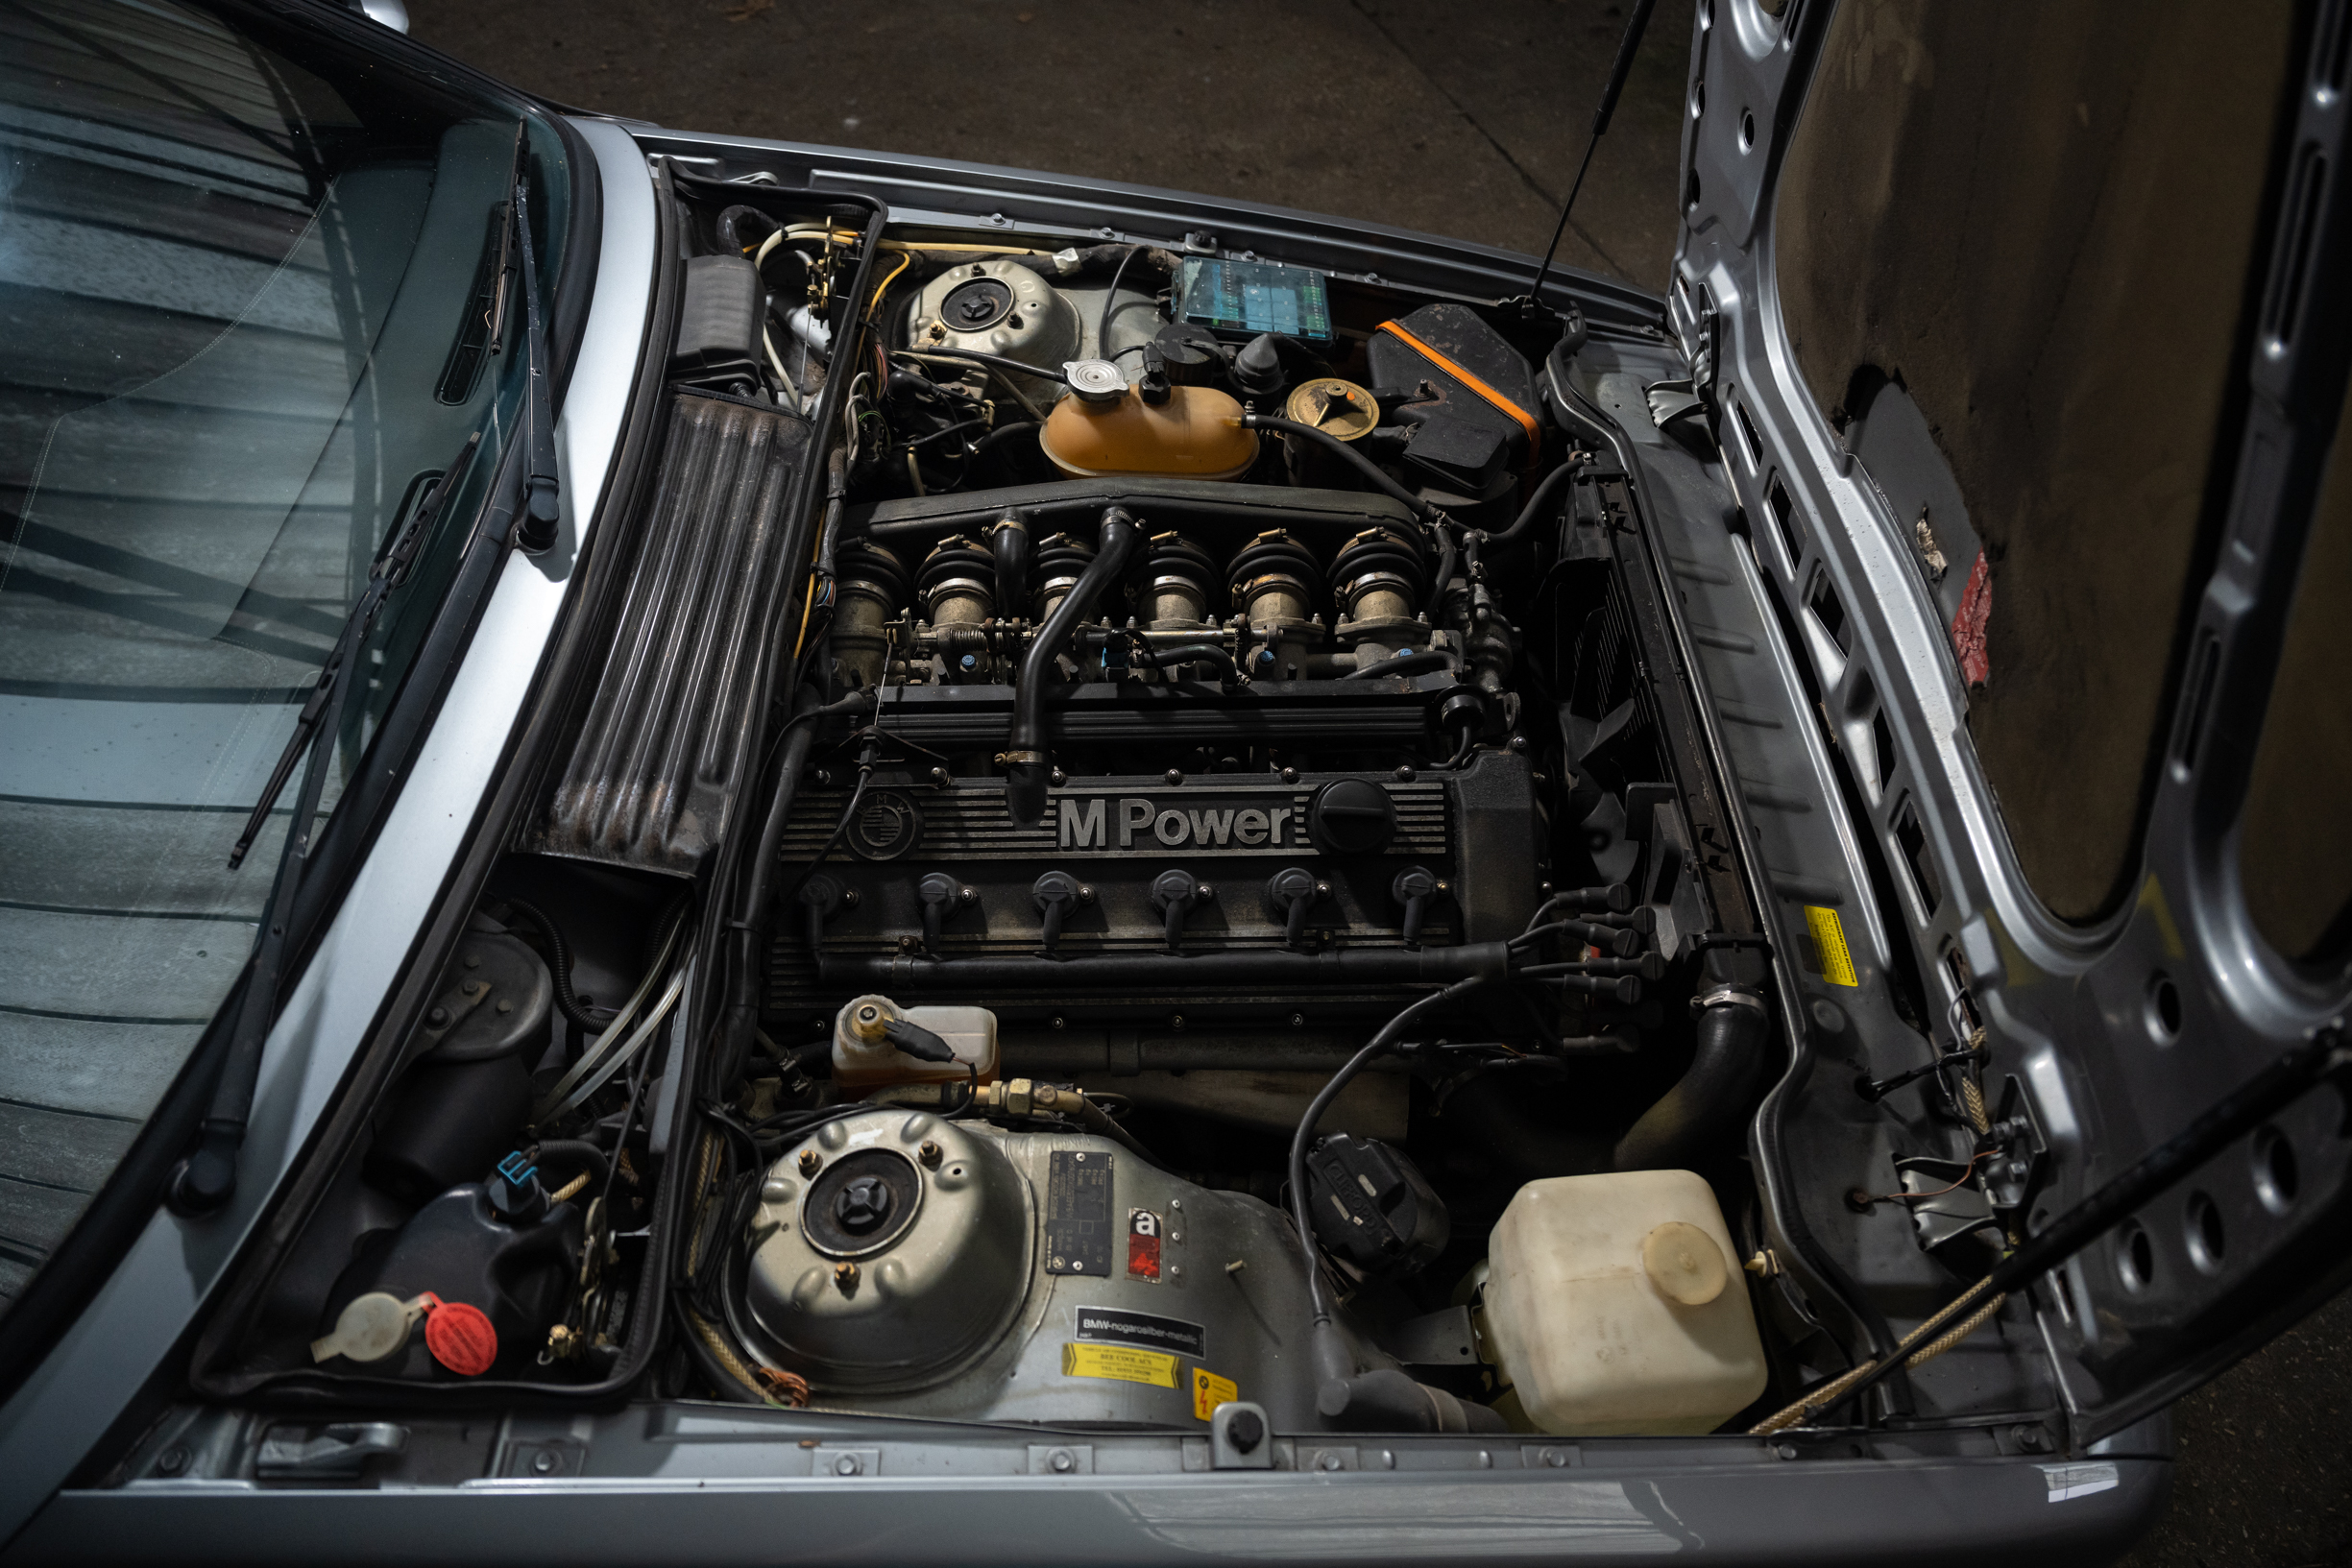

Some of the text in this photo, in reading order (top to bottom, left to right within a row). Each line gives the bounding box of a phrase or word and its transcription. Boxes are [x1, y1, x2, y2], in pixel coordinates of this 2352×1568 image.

[856, 793, 910, 815] BMW
[1060, 798, 1292, 847] M Power
[1327, 1163, 1379, 1231] CLIFFORD
[1135, 1212, 1156, 1237] a
